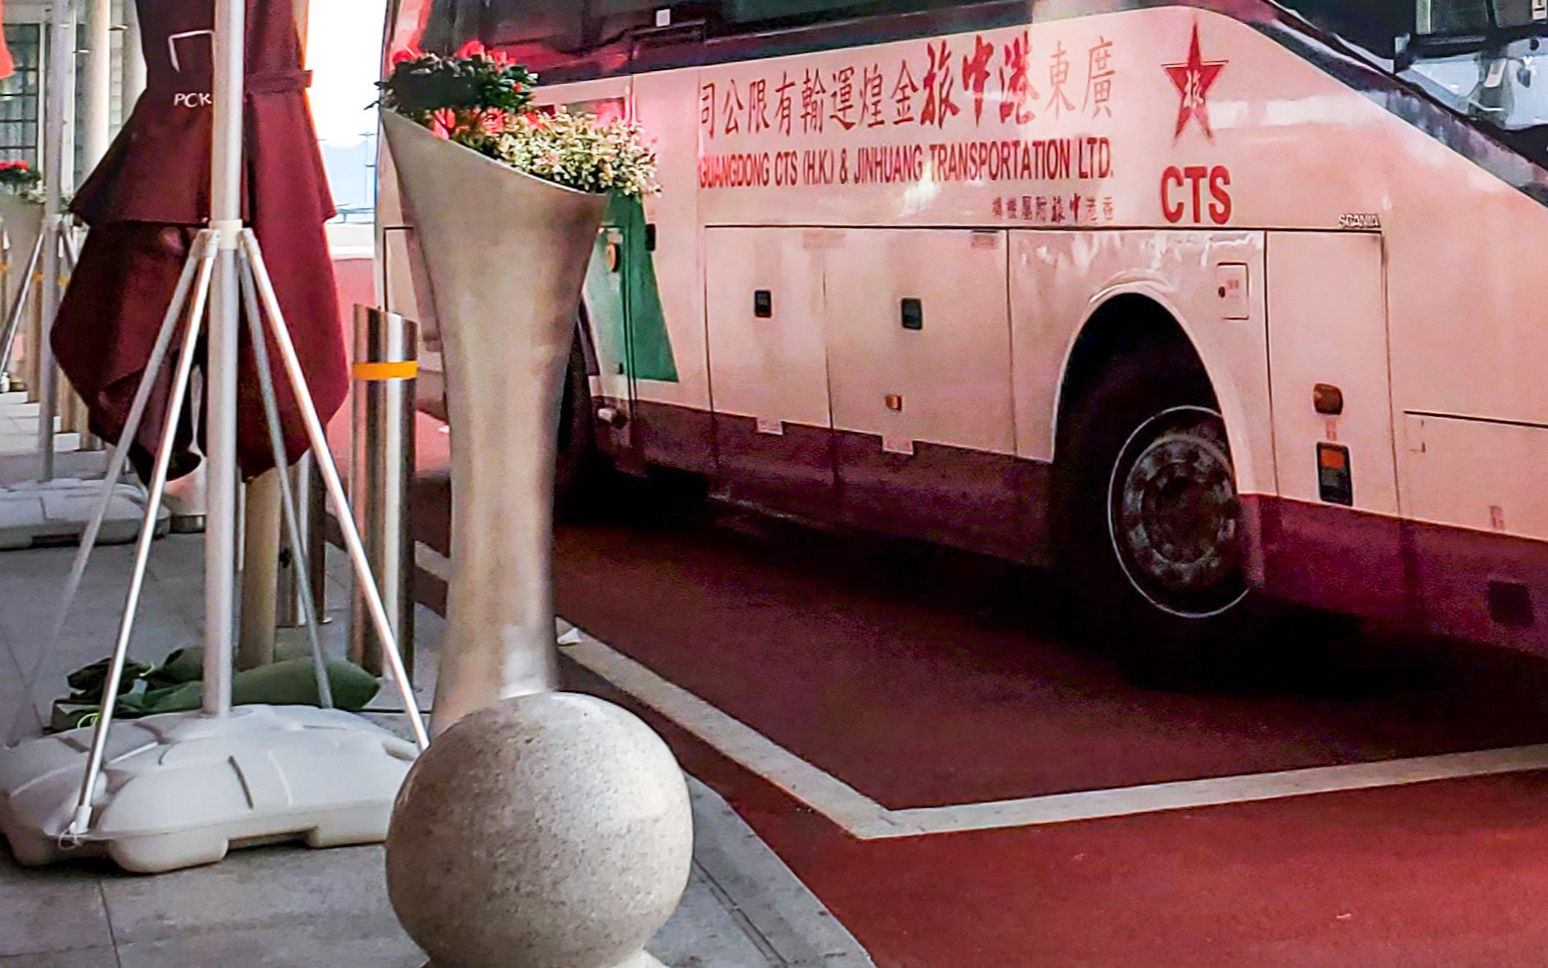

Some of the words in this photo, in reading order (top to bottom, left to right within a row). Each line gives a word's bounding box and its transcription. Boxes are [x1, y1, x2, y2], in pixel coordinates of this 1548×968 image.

[699, 151, 769, 188] GUANGDONG
[774, 150, 798, 186] CTS
[839, 148, 849, 184] &
[854, 144, 923, 183] JINHUANG
[929, 138, 1071, 181] TRANSPORTATION
[1161, 165, 1232, 225] CTS
